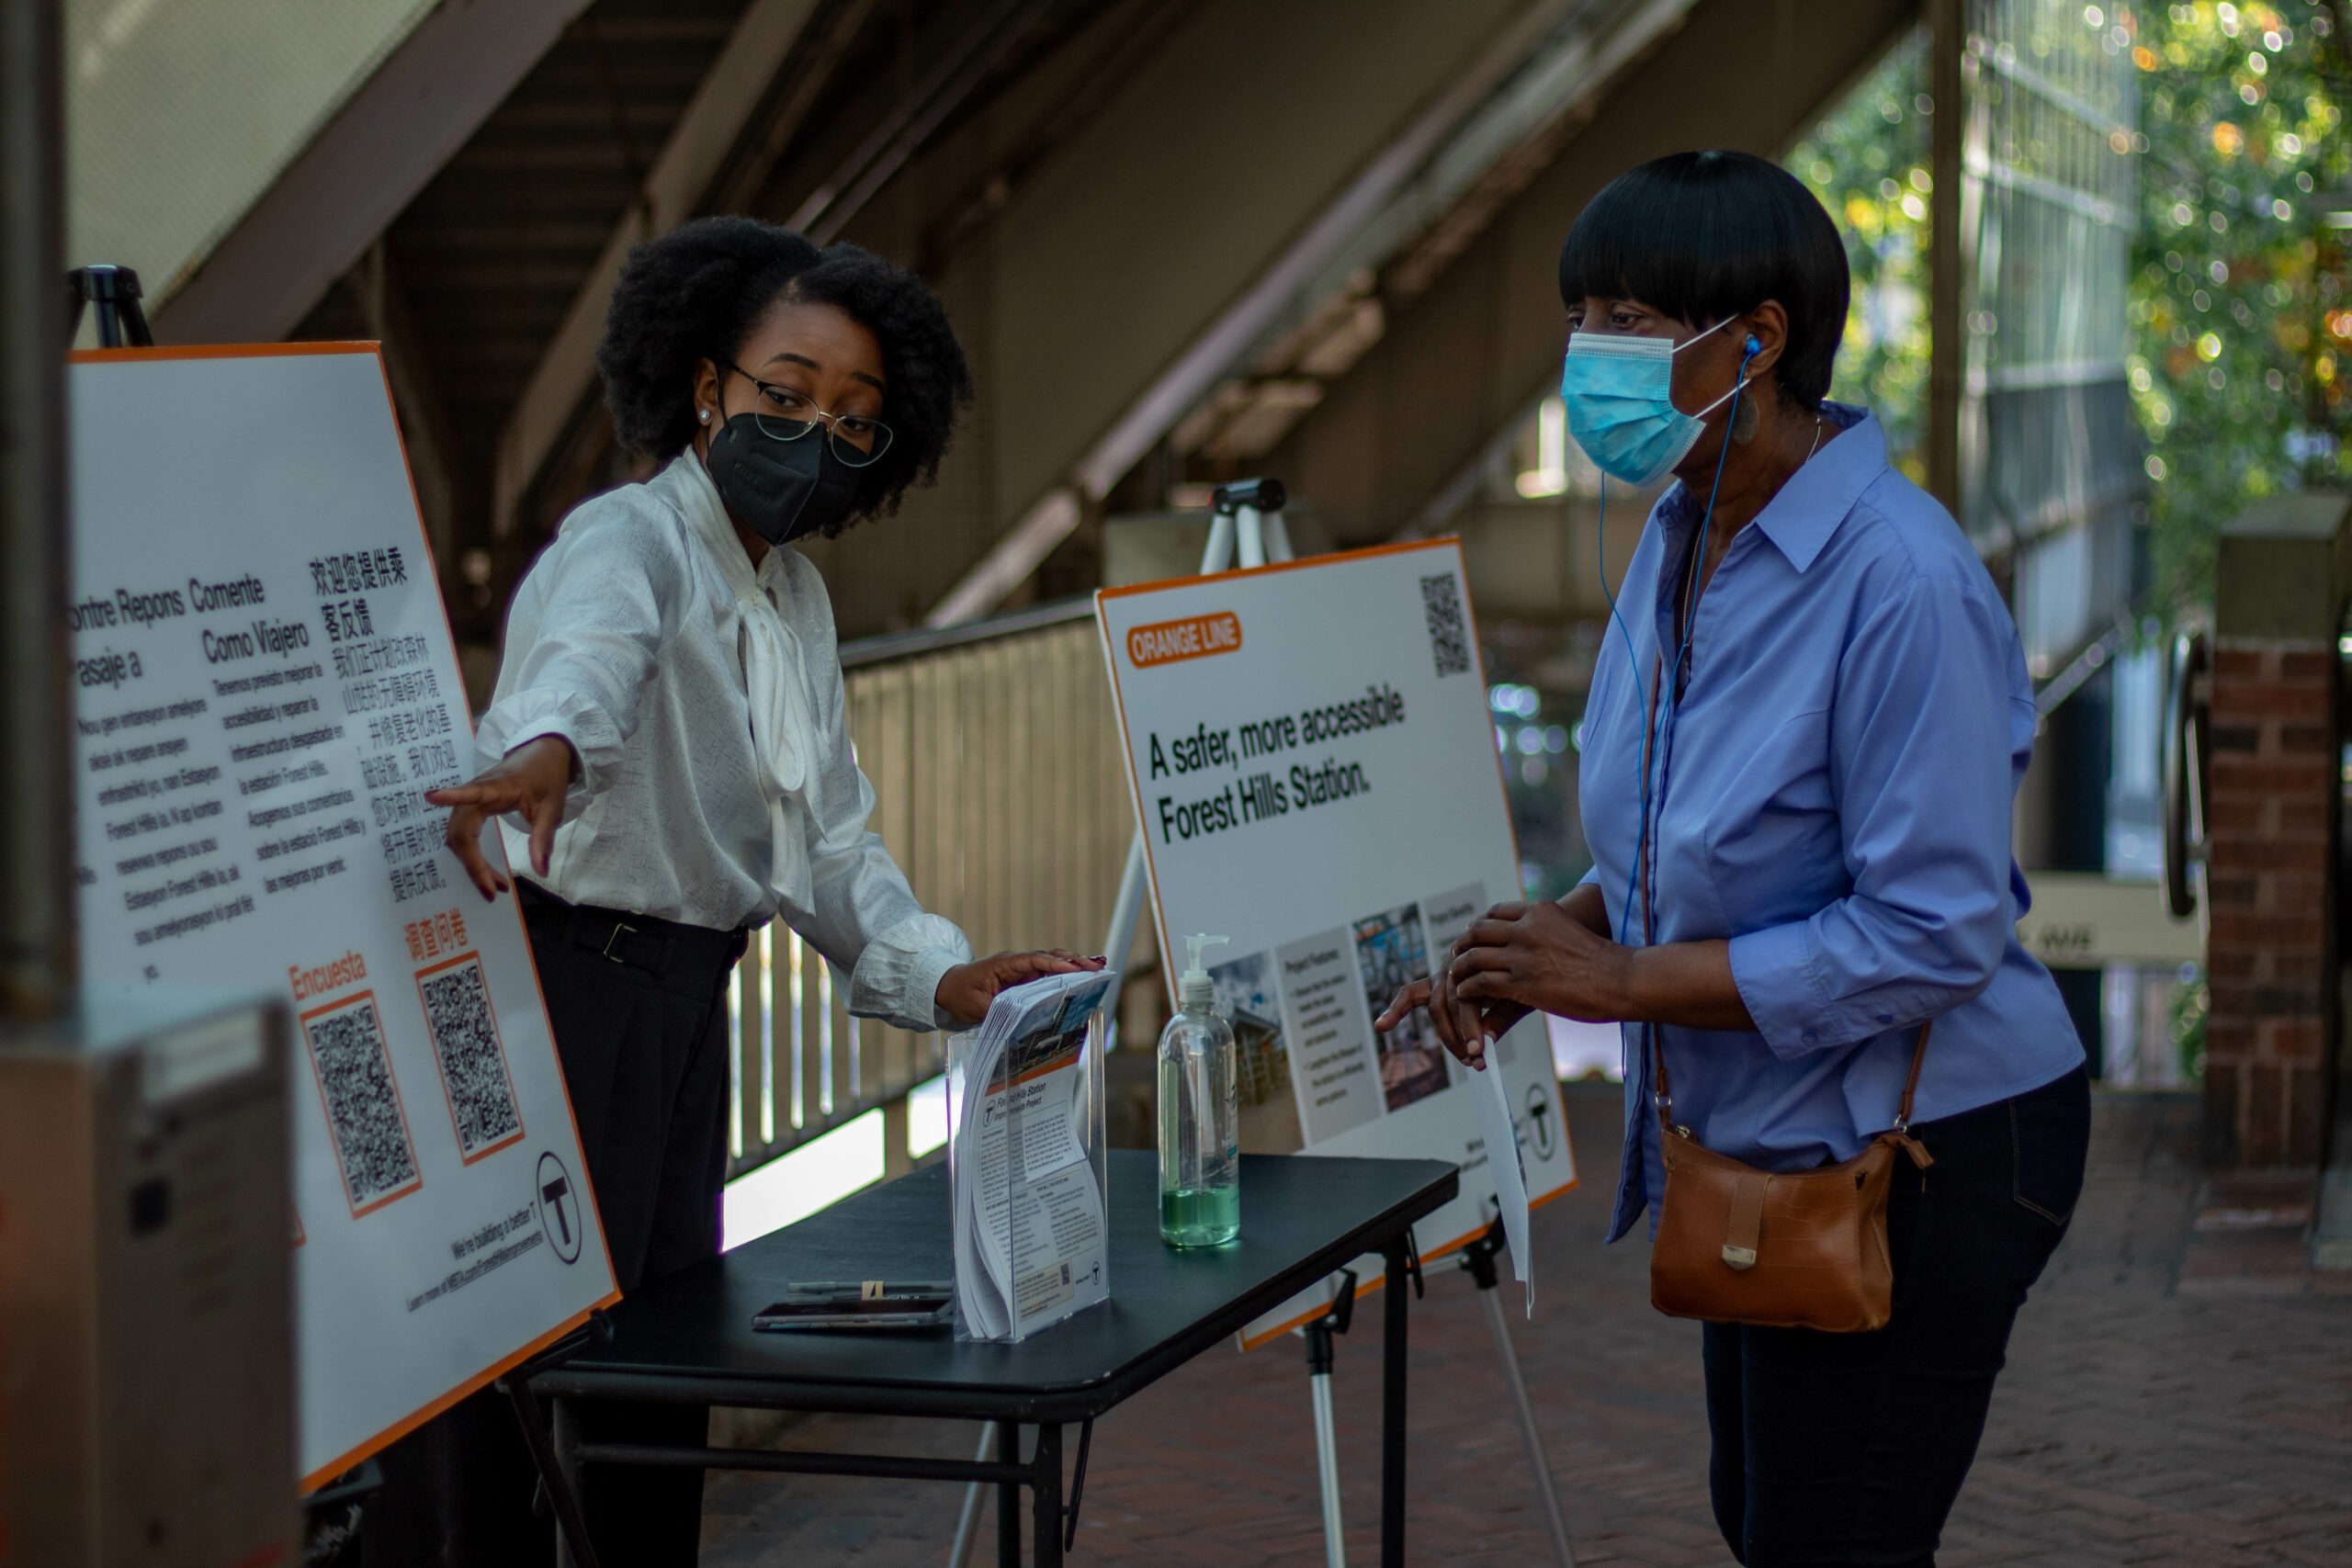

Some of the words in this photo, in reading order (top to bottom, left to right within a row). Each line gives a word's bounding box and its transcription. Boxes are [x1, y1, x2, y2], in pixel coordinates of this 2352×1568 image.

[309, 547, 407, 595] 欢迎您提供乘
[116, 587, 185, 628] Repons
[189, 573, 265, 613] Comente
[202, 629, 254, 663] Como
[252, 618, 309, 659] Viajero
[321, 597, 374, 642] 客反馈
[1132, 624, 1201, 662] ORANGE
[1200, 616, 1238, 649] LINE
[72, 646, 128, 691] asaje
[129, 651, 142, 678] a
[212, 678, 252, 697] Tenemos
[252, 670, 283, 694] previsto
[284, 665, 313, 686] mejorar
[313, 663, 324, 677] la
[222, 703, 277, 730] accesibilidad
[281, 699, 310, 721] reparar
[309, 694, 319, 711] la
[1150, 732, 1170, 780] A
[1172, 722, 1238, 774] safer,
[1239, 715, 1297, 760] more
[1301, 682, 1406, 745] accessible
[238, 777, 249, 796] la
[281, 764, 310, 786] Forest
[1159, 784, 1238, 845] Forest
[1237, 771, 1288, 825] Hills
[1289, 755, 1370, 810] Station.
[248, 806, 292, 829] Acogemos
[291, 801, 308, 818] sus
[307, 787, 355, 814] comentarios
[106, 819, 138, 841] Forest
[256, 841, 280, 862] sobre
[317, 821, 345, 844] Forest
[165, 879, 199, 903] Forest
[404, 908, 469, 963] 调查问卷
[288, 949, 368, 1001] Encuesta
[1026, 1096, 1043, 1110] Project
[1027, 1083, 1046, 1097] Station
[474, 1220, 503, 1250] building
[503, 1220, 511, 1235] a
[510, 1207, 531, 1231] better
